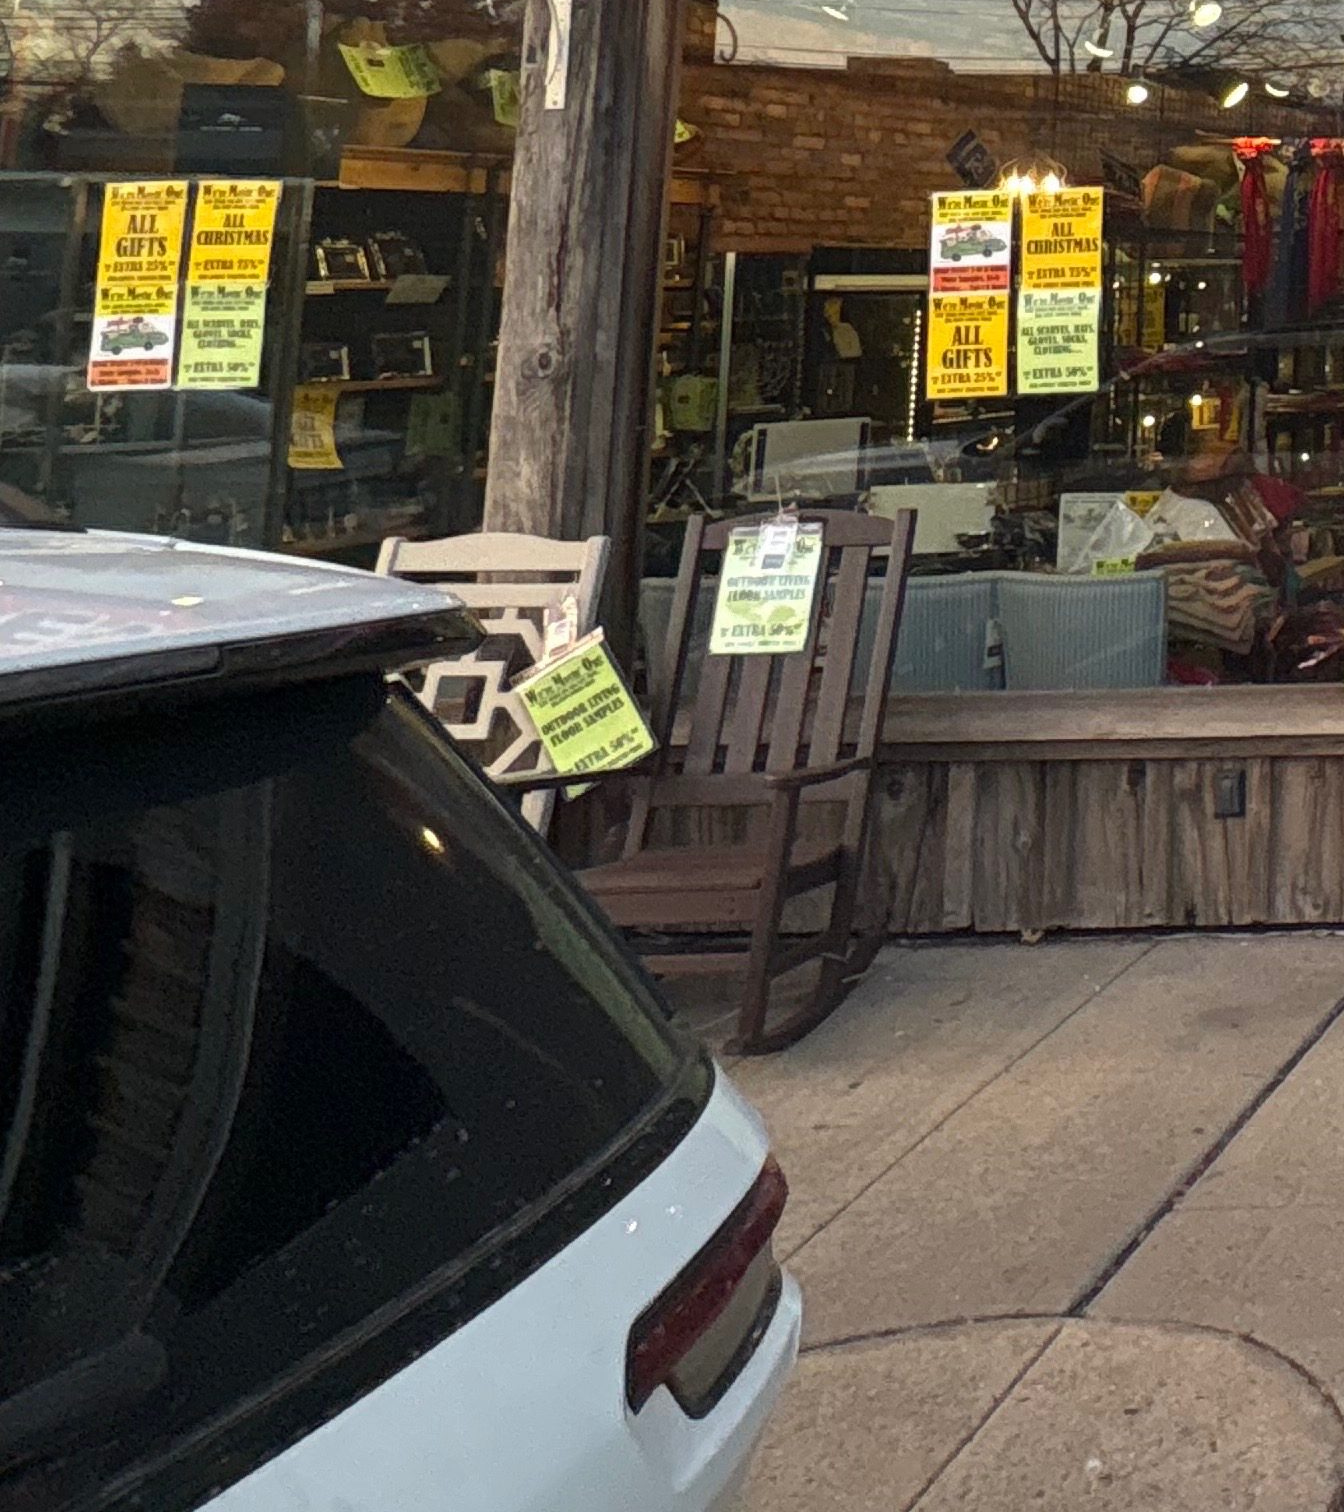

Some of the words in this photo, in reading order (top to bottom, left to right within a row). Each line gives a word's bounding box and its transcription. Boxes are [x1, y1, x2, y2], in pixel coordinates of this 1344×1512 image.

[127, 214, 159, 234] ALL
[1051, 222, 1074, 238] ALL
[116, 236, 168, 258] GIFTS
[1026, 238, 1099, 255] CHRISTMAS
[951, 325, 984, 346] ALL
[941, 348, 993, 369] GIFTS
